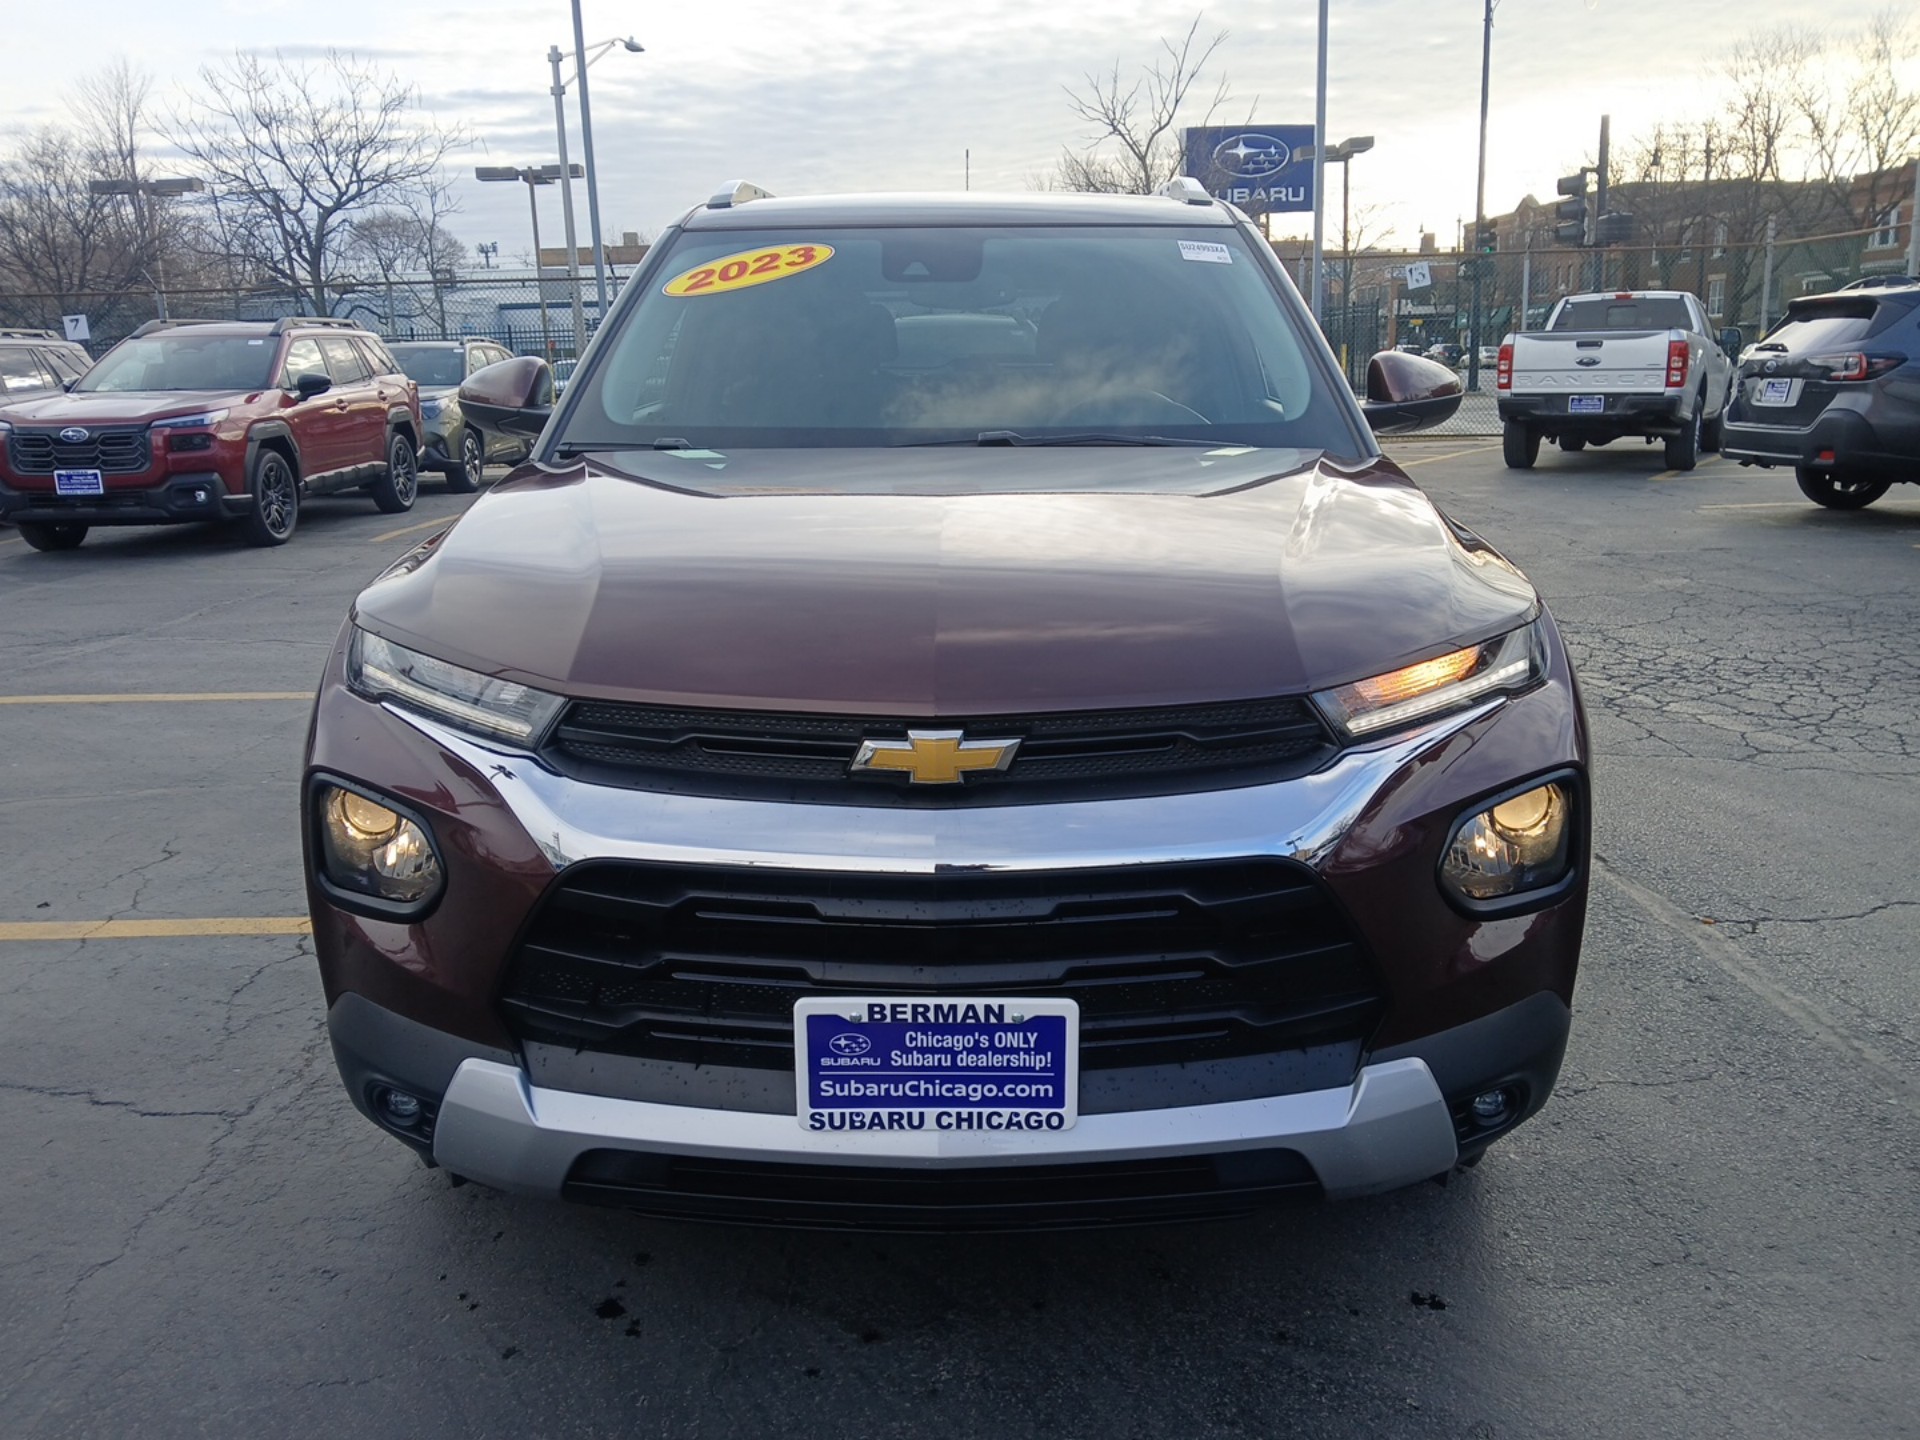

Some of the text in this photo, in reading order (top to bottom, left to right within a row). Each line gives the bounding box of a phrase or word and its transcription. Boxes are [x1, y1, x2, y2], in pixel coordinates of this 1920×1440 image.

[1215, 186, 1305, 203] UBARU
[683, 246, 818, 293] 2023
[70, 318, 80, 332] 7
[1515, 374, 1661, 386] RANGER
[867, 1003, 1005, 1023] BERMAN
[904, 1031, 1039, 1052] Chicago's ONLY
[820, 1057, 881, 1067] SUBARU
[890, 1050, 1052, 1071] Subaru dealership!
[819, 1079, 1054, 1102] SubaruChicago.com
[809, 1111, 1065, 1131] SUBARU CHICAGO
